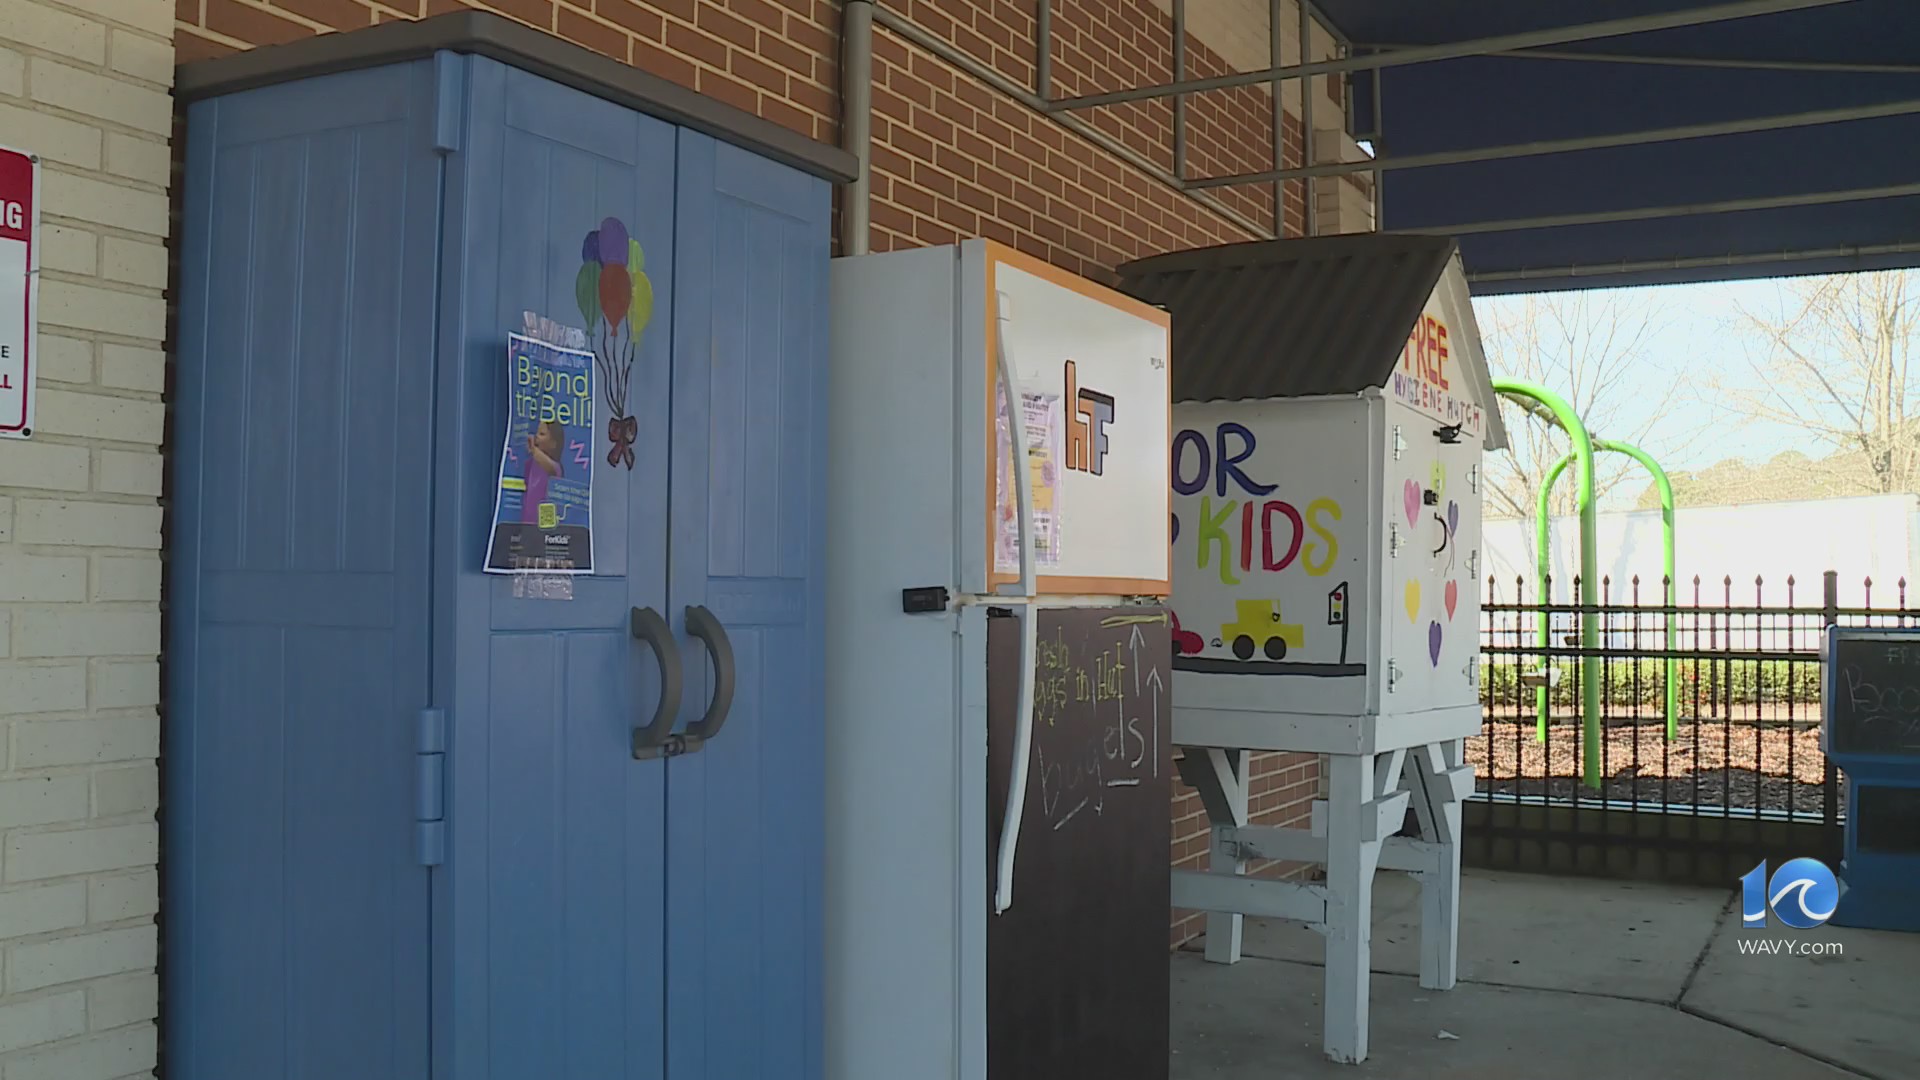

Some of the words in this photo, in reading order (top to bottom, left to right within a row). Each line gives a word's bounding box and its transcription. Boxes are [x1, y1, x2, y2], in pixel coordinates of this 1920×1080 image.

[517, 356, 589, 396] Beyond
[539, 394, 592, 428] Bell!
[1197, 496, 1342, 585] KIDS
